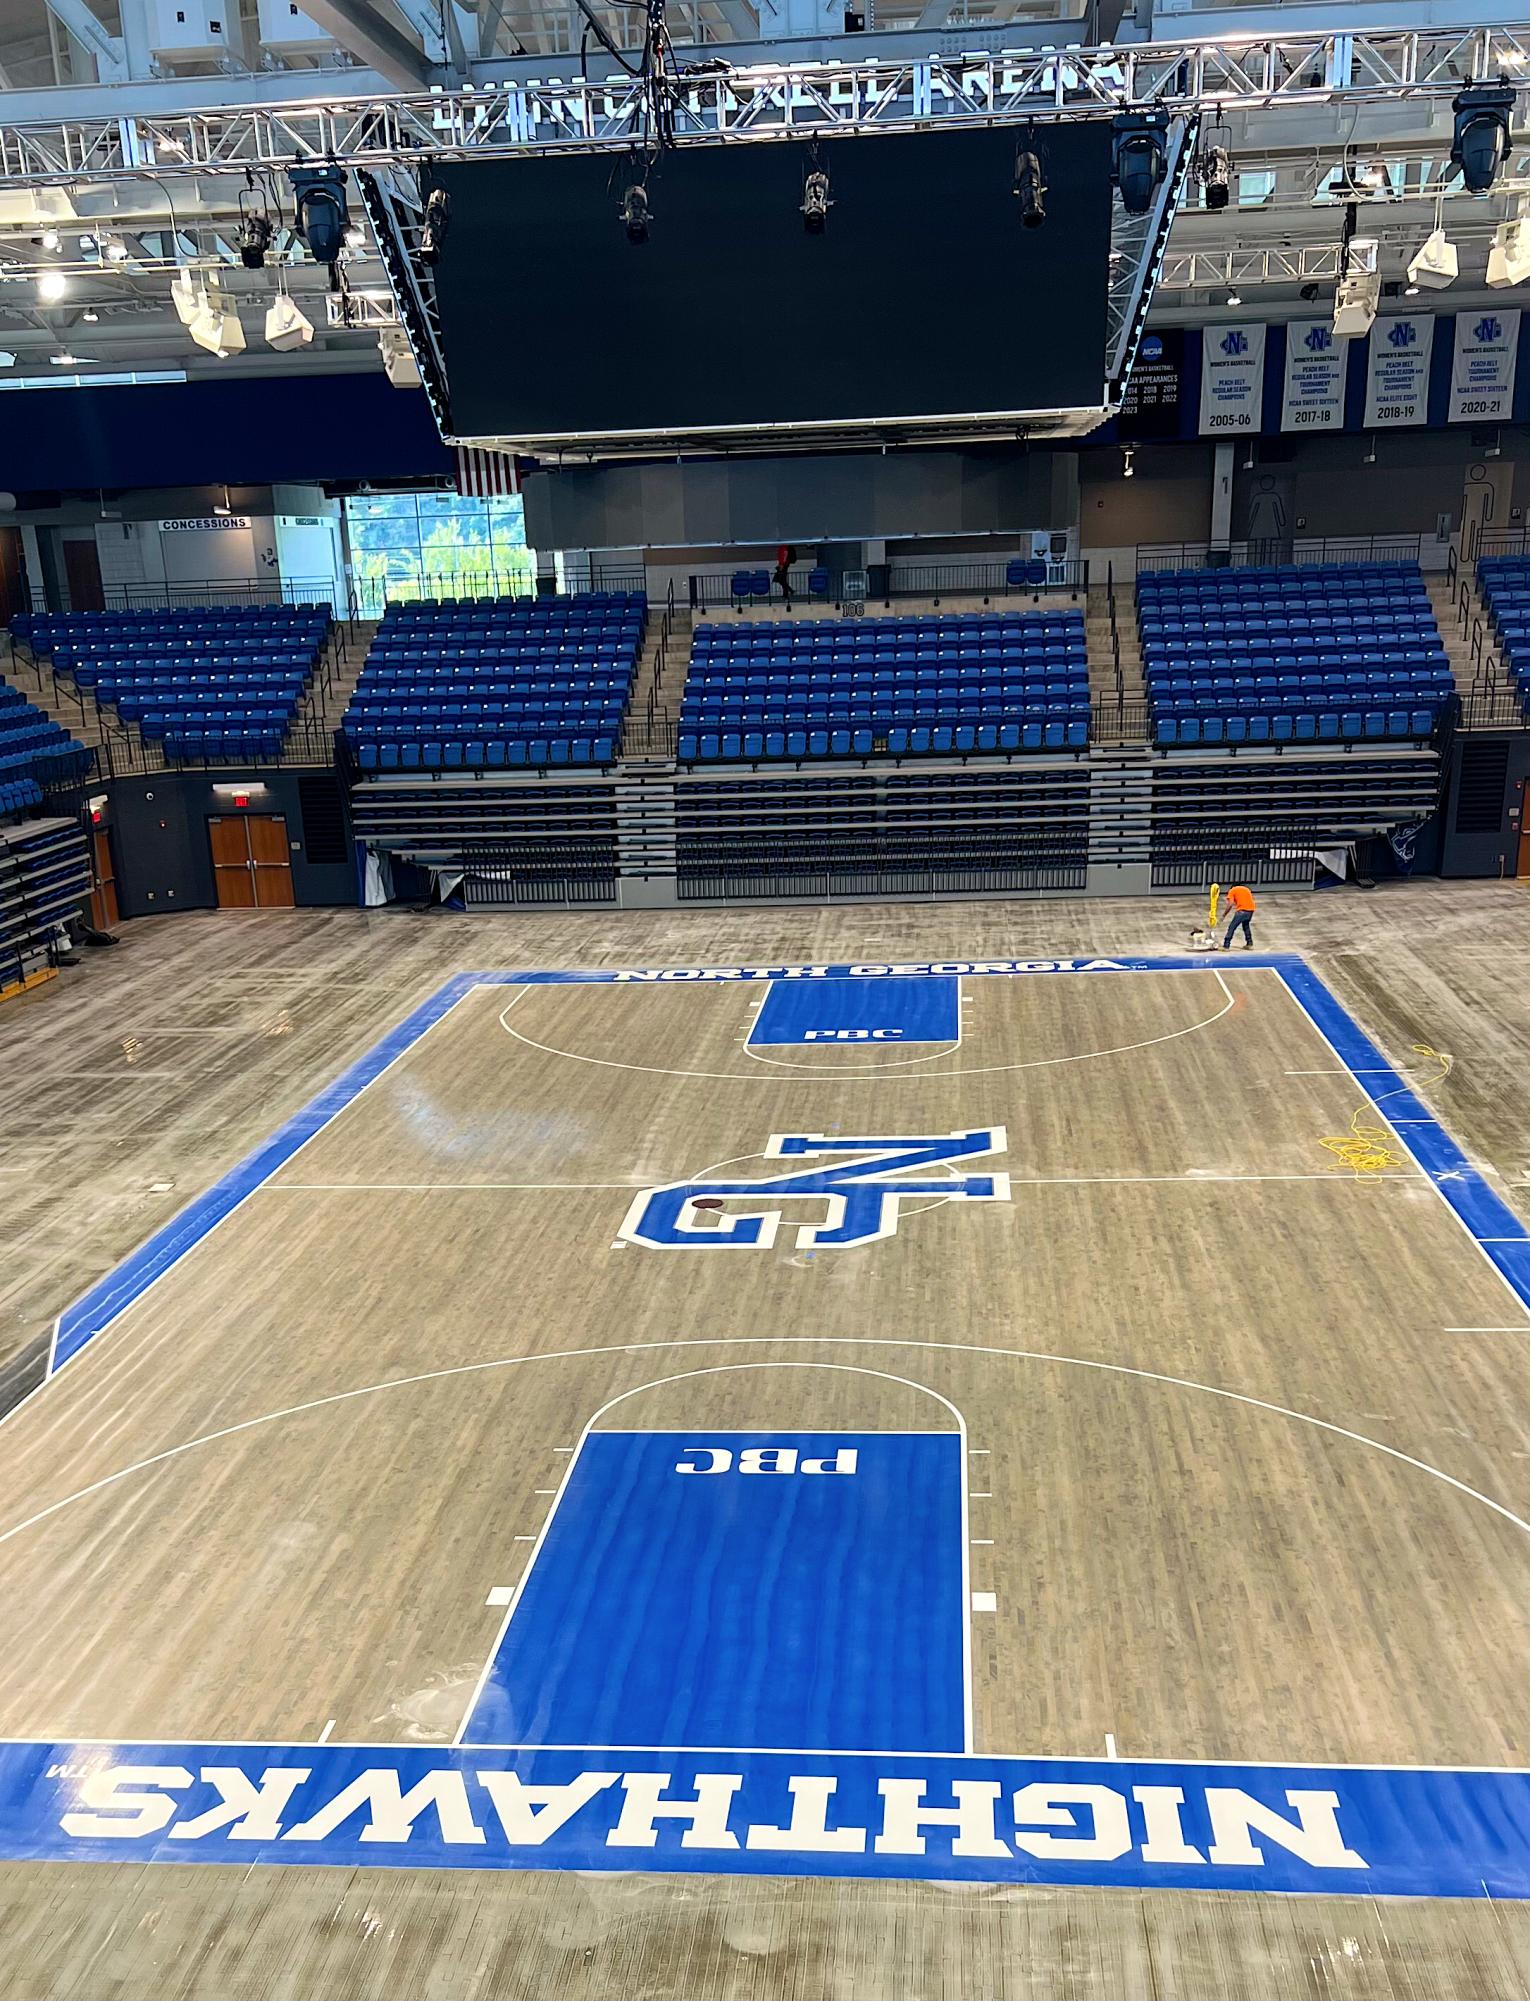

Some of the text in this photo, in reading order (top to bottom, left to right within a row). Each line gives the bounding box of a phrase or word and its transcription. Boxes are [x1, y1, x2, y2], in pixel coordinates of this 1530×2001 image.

[1142, 347, 1163, 356] NCAA
[1139, 375, 1178, 384] APPEARANCES
[1127, 384, 1178, 395] 014 2018 2019
[1143, 395, 1157, 404] 2021
[1162, 394, 1178, 403] 2022
[1122, 406, 1138, 415] 2023
[1377, 405, 1415, 419] 2018-19
[1460, 400, 1501, 414] 2020-21
[1209, 413, 1251, 427] 2005-06
[1294, 410, 1331, 424] 2017-18
[163, 518, 246, 530] CONCESSIONS
[842, 603, 865, 617] 106
[613, 966, 829, 981] NORTH
[848, 959, 1131, 977] GEORGIA
[804, 1028, 904, 1040] PBC
[675, 1448, 858, 1475] PBC
[58, 1765, 1371, 1869] NIGHTHAWKS
